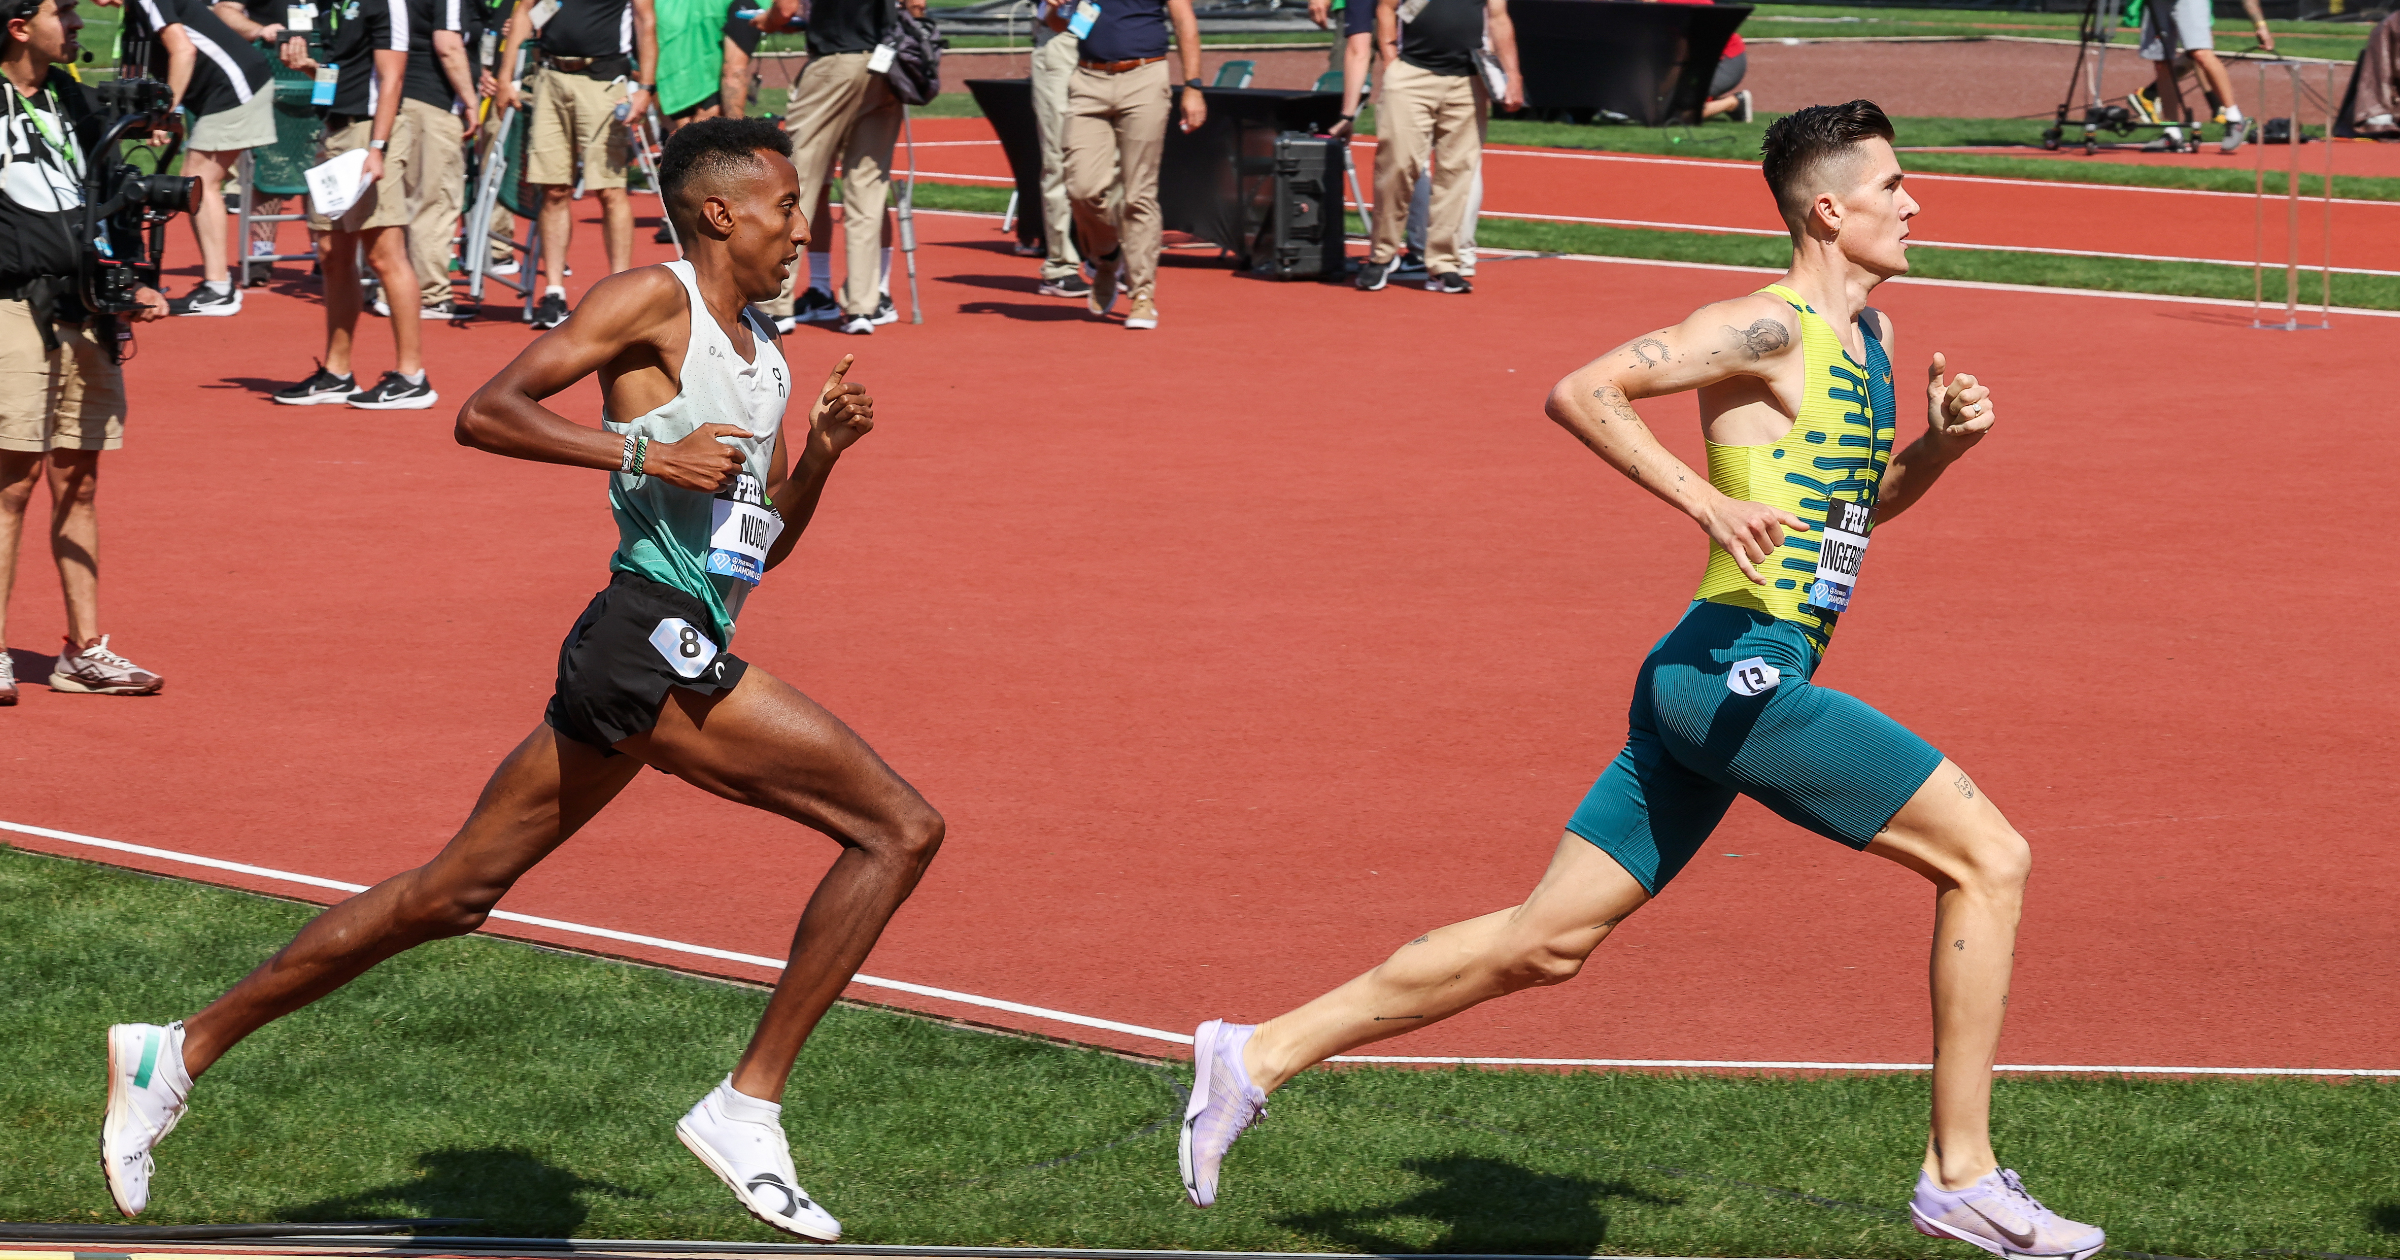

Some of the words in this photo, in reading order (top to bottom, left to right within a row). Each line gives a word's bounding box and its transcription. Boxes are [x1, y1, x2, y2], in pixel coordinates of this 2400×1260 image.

[733, 473, 761, 505] PRE
[1839, 502, 1870, 535] PRE
[679, 626, 702, 659] 8
